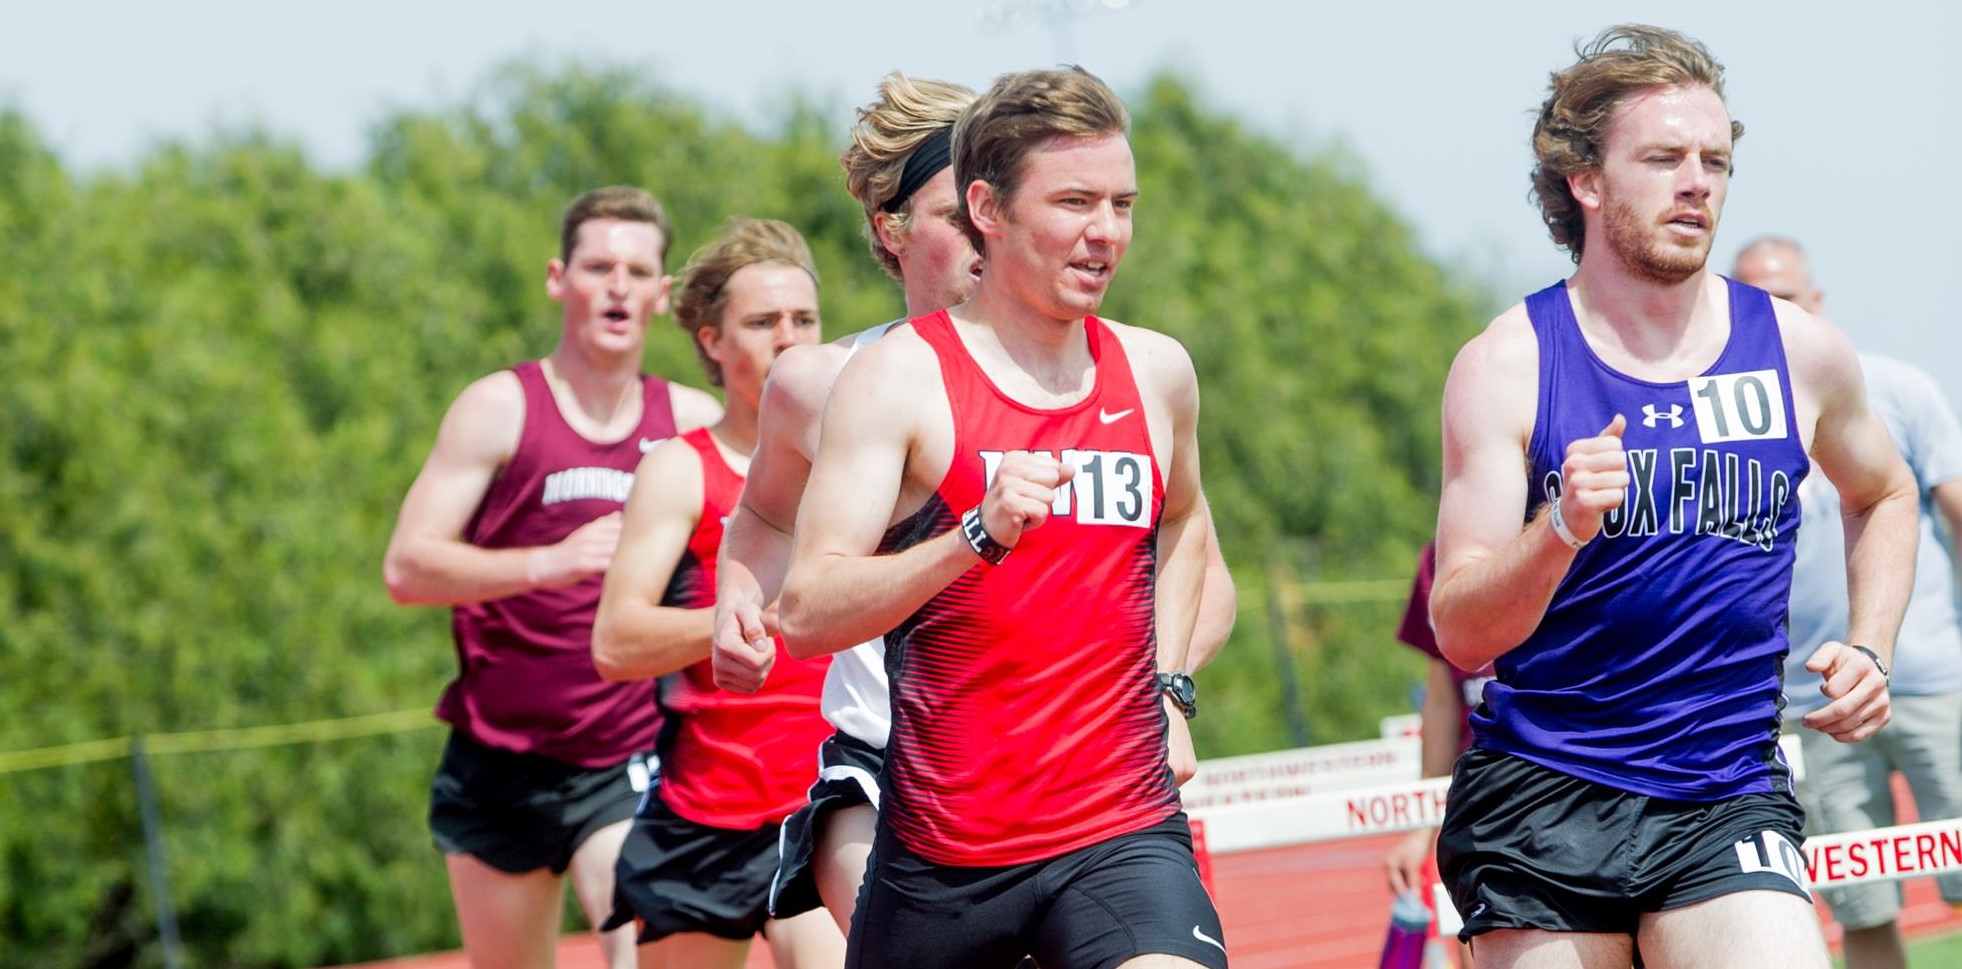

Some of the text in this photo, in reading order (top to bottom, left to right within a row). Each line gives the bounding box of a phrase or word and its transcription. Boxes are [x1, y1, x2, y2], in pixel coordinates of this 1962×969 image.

[1697, 375, 1773, 438] 10
[1082, 454, 1143, 522] 13
[1742, 831, 1803, 887] 10
